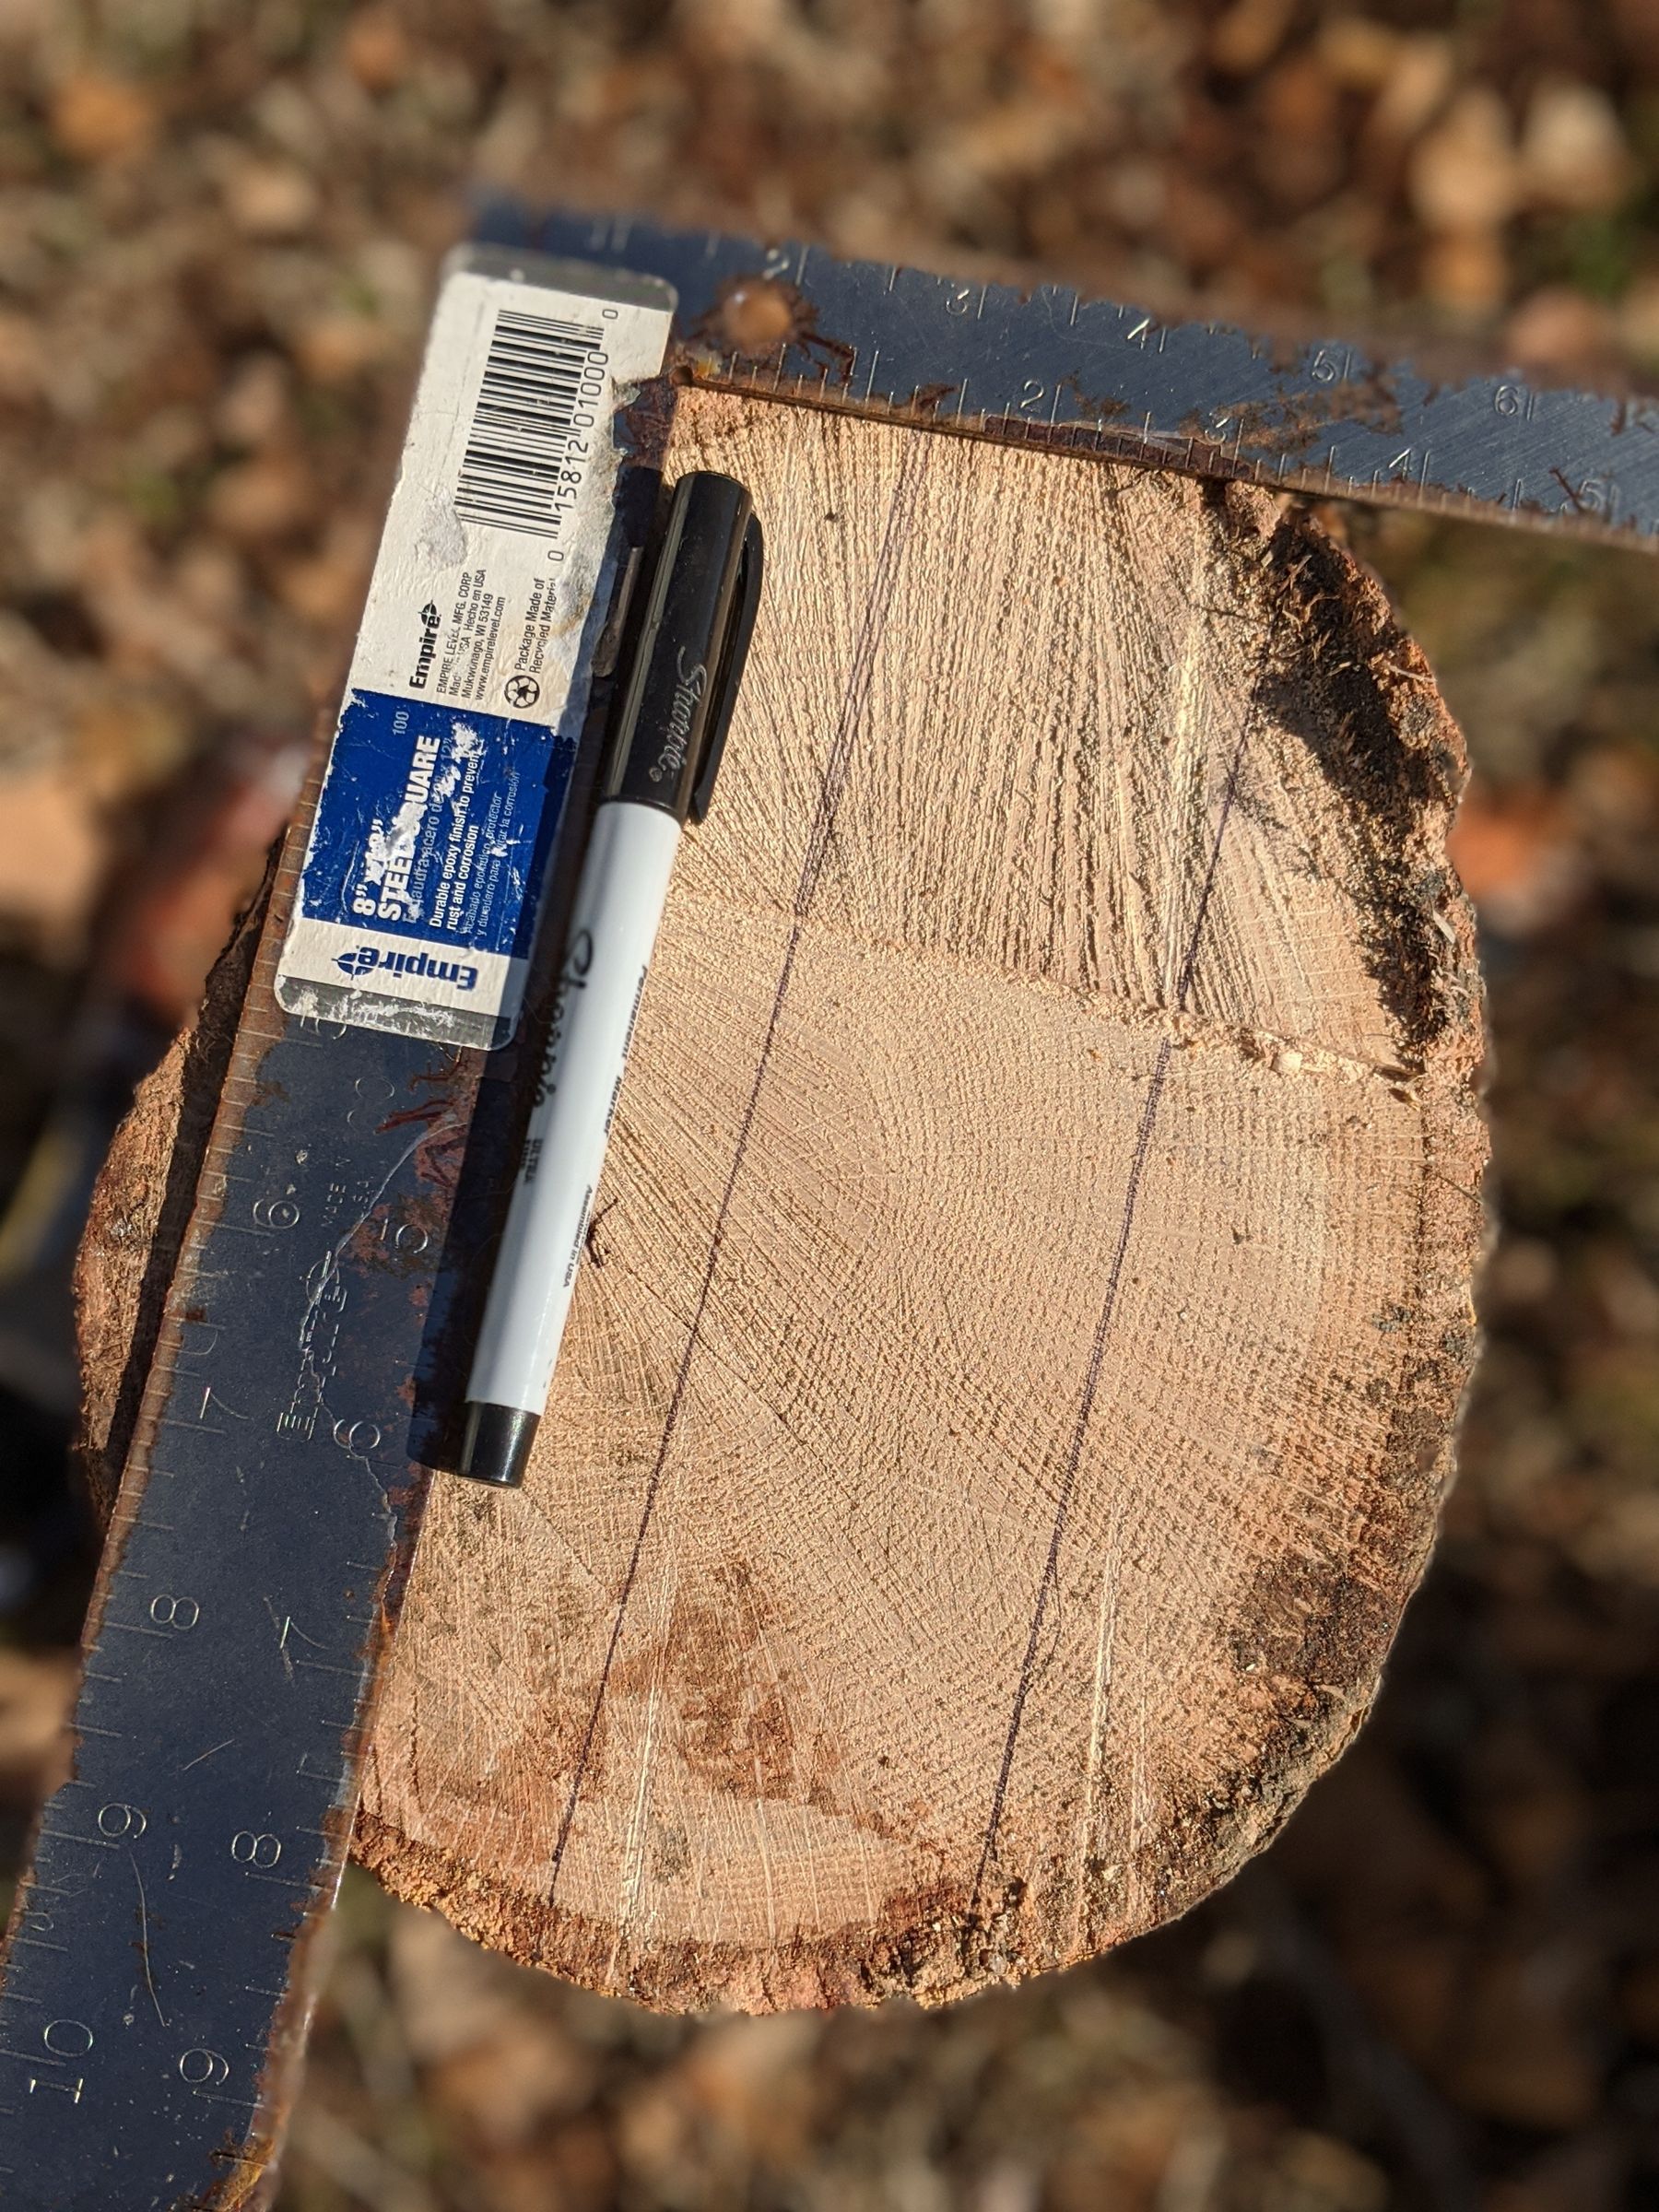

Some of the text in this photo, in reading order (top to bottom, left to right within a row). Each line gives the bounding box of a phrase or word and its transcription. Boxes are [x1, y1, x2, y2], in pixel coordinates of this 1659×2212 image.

[1019, 379, 1045, 413] 2
[1494, 383, 1519, 418] 6
[547, 309, 618, 562] 0 15812 01000 0
[458, 571, 472, 597] CORP
[472, 590, 481, 600] en
[474, 569, 486, 587] USA
[452, 600, 466, 624] MFG.
[464, 603, 478, 630] Hecho
[514, 578, 545, 670] Package Made of
[409, 613, 442, 689] Empire
[461, 593, 493, 698] Mukwonago, WI 53149
[475, 595, 505, 700] www.empirelevel.com
[436, 658, 453, 693] EMPIRE
[392, 710, 410, 735] 100
[660, 646, 708, 775] Sharpie
[458, 795, 470, 807] to
[449, 809, 466, 841] finish
[442, 844, 461, 879] epoxy
[446, 824, 479, 930] rust and corrosion
[429, 882, 451, 927] Durable
[356, 946, 478, 991] Empire
[253, 1198, 300, 1230] 6
[562, 1263, 574, 1288] USA
[200, 1386, 250, 1420] 7
[332, 1418, 382, 1452] 6
[149, 1593, 200, 1630] 8
[278, 1615, 331, 1651] 7
[97, 1802, 147, 1840] 9
[230, 1830, 282, 1869] 8
[29, 2018, 94, 2105] 10
[179, 2047, 230, 2087] 9
